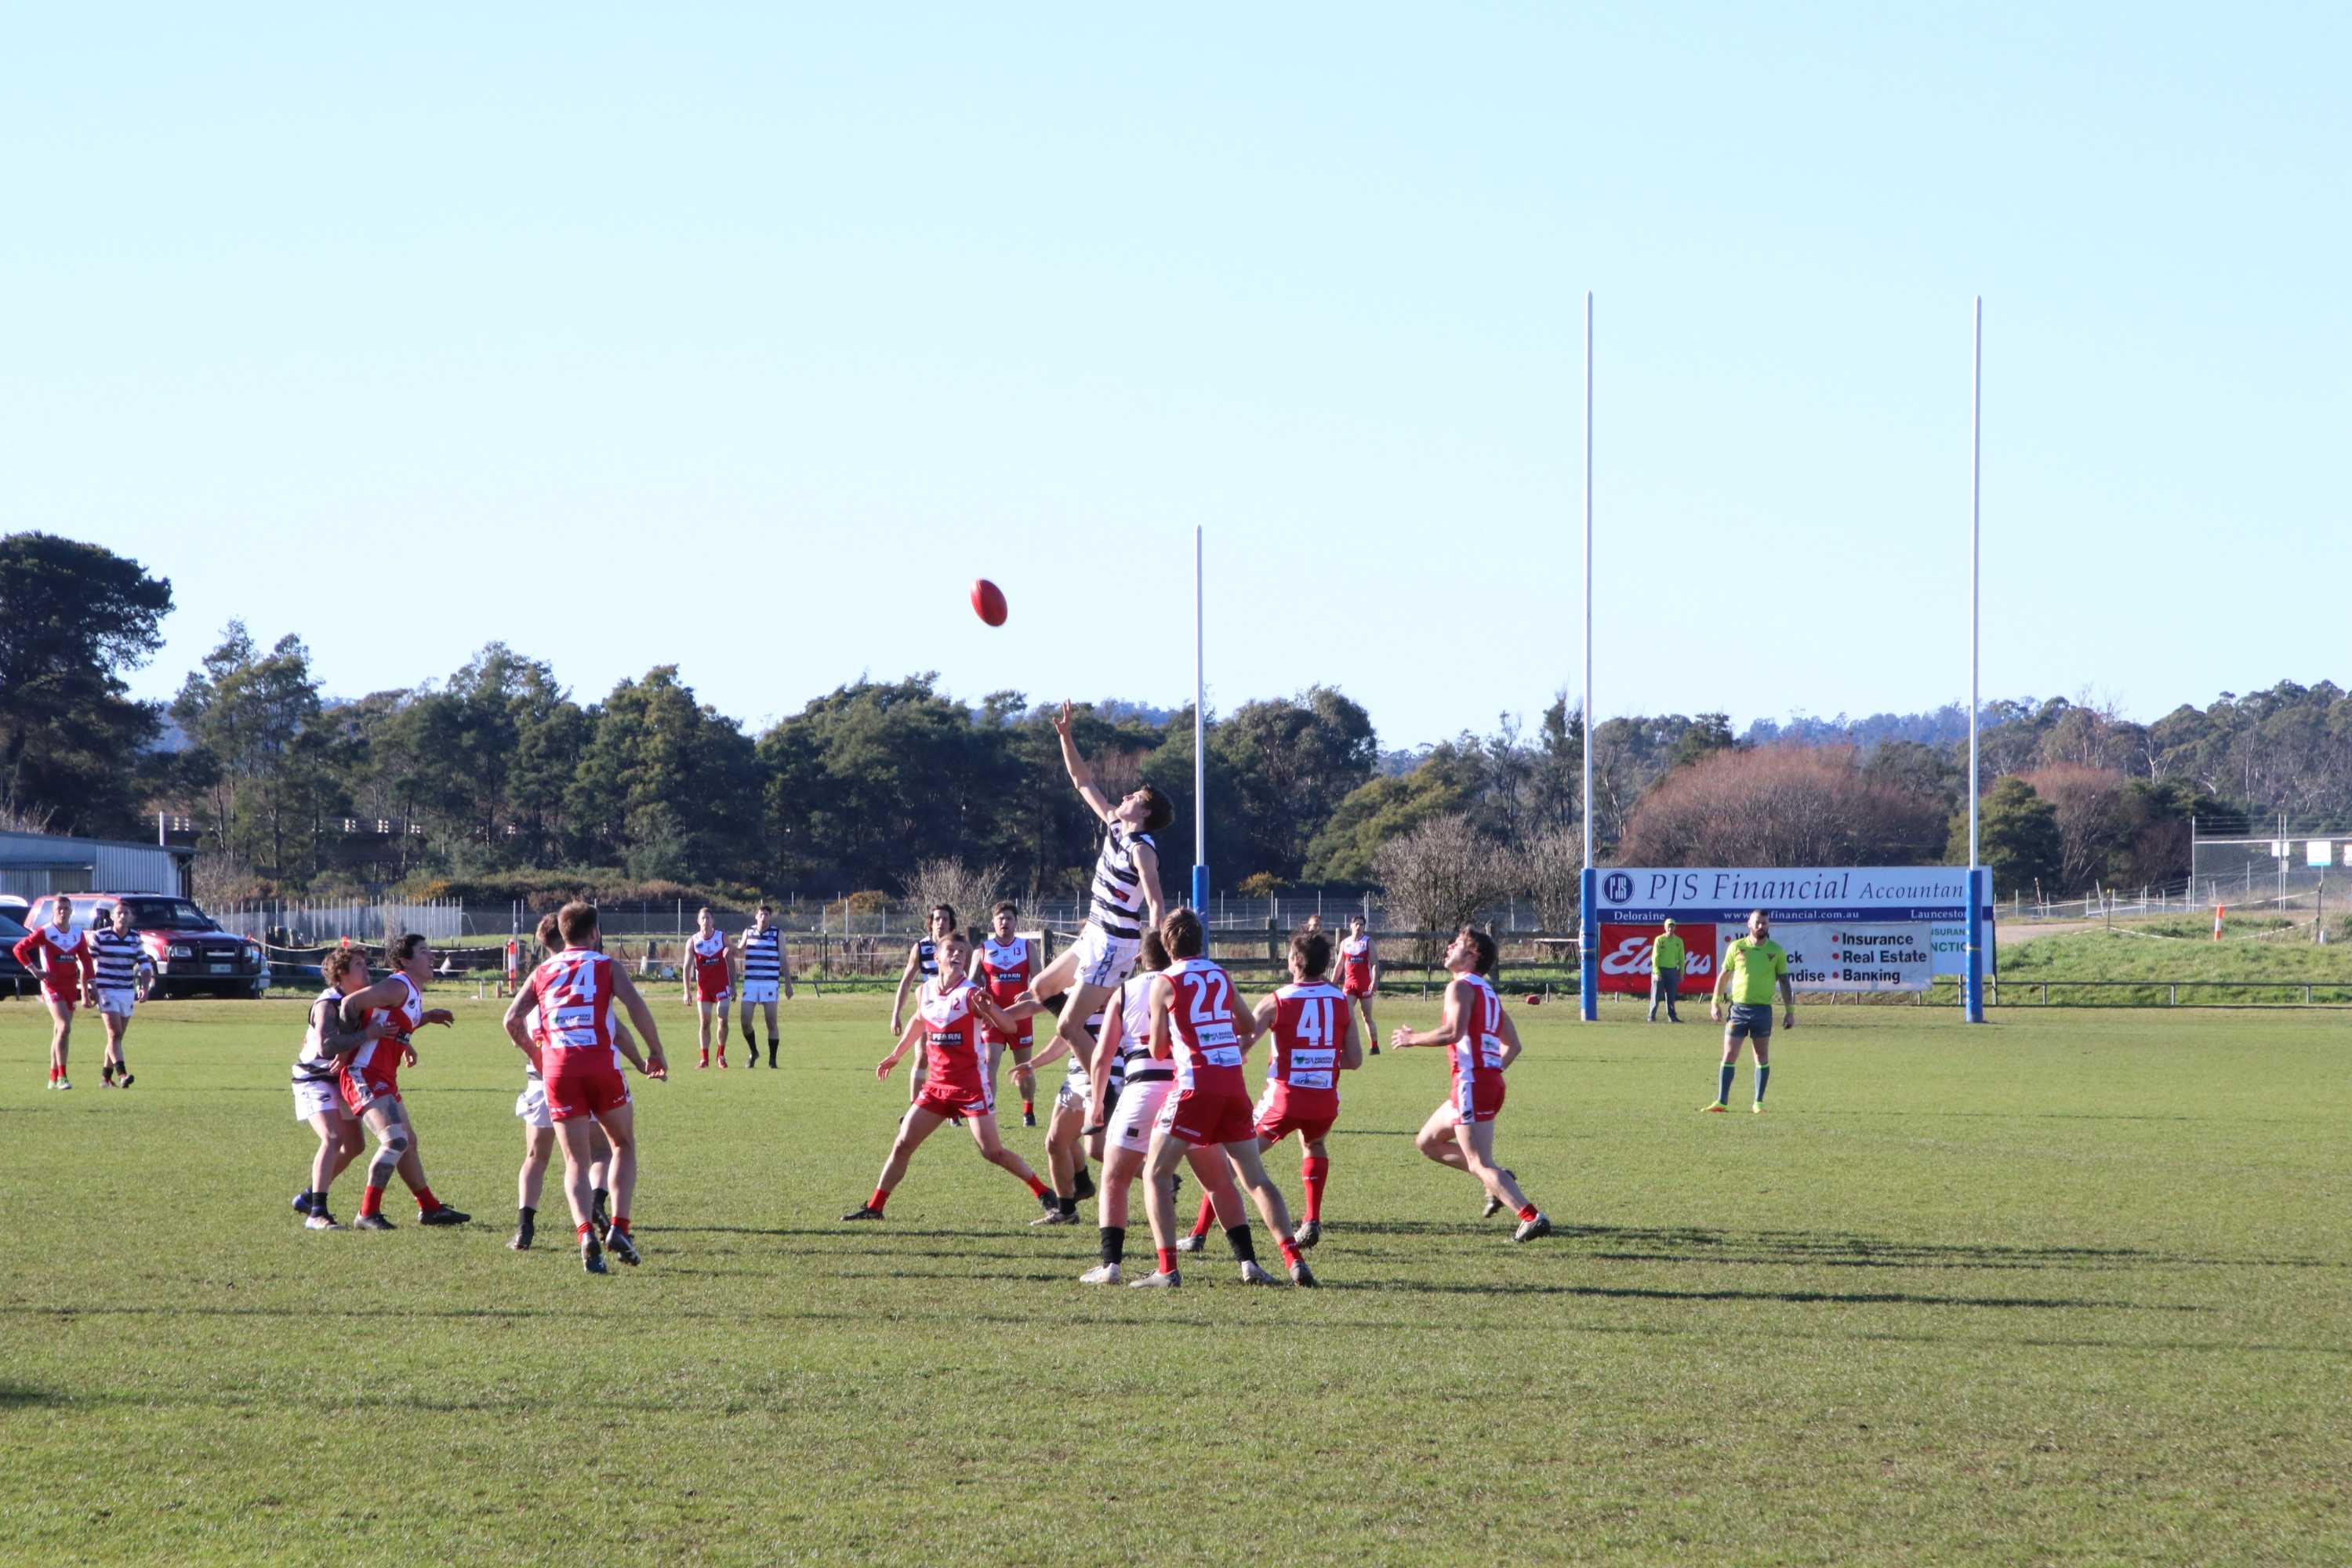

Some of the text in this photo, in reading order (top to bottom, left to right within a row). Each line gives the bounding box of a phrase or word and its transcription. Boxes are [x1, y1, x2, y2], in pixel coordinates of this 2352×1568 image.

[1648, 873, 1963, 906] PJS Financial Accountan
[1613, 910, 1666, 920] Deloraine
[1911, 909, 1966, 919] Launcesto
[1842, 932, 1914, 946] Insurance
[1601, 937, 1711, 975] Elrs
[1842, 949, 1927, 964] Real Estate
[544, 959, 597, 1008] 24
[1842, 969, 1900, 985] Banking
[1183, 970, 1231, 1024] 22
[1296, 997, 1334, 1047] 41
